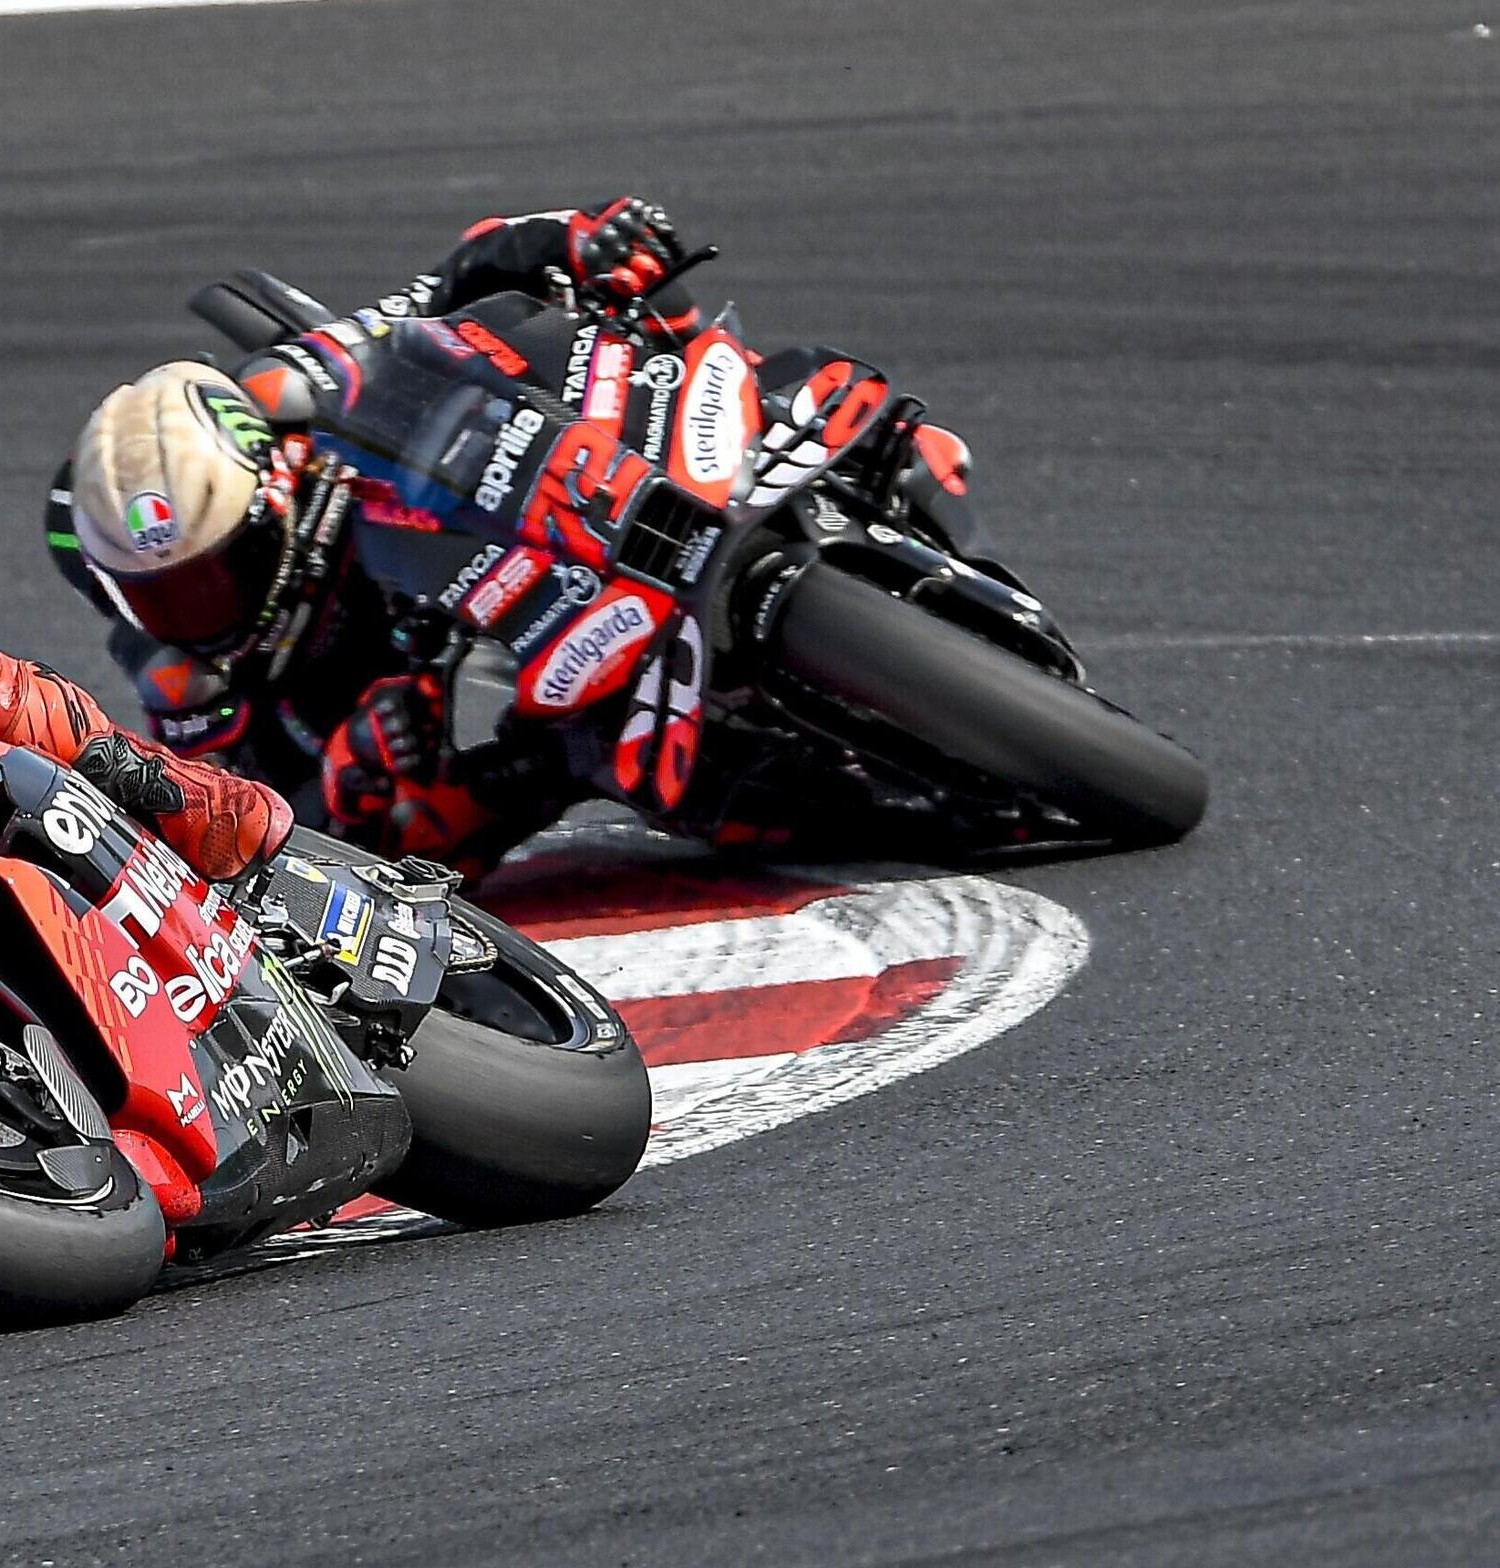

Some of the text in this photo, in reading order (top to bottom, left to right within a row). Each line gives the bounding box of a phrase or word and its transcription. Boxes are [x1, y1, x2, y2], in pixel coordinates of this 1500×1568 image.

[475, 408, 546, 513] aprilia
[692, 354, 736, 473] sterilgarda
[520, 422, 652, 572] 72
[544, 604, 643, 701] sterilgarda
[164, 931, 241, 1024] elica
[211, 1006, 300, 1122] MONSTER
[246, 1059, 308, 1137] ENERGY
